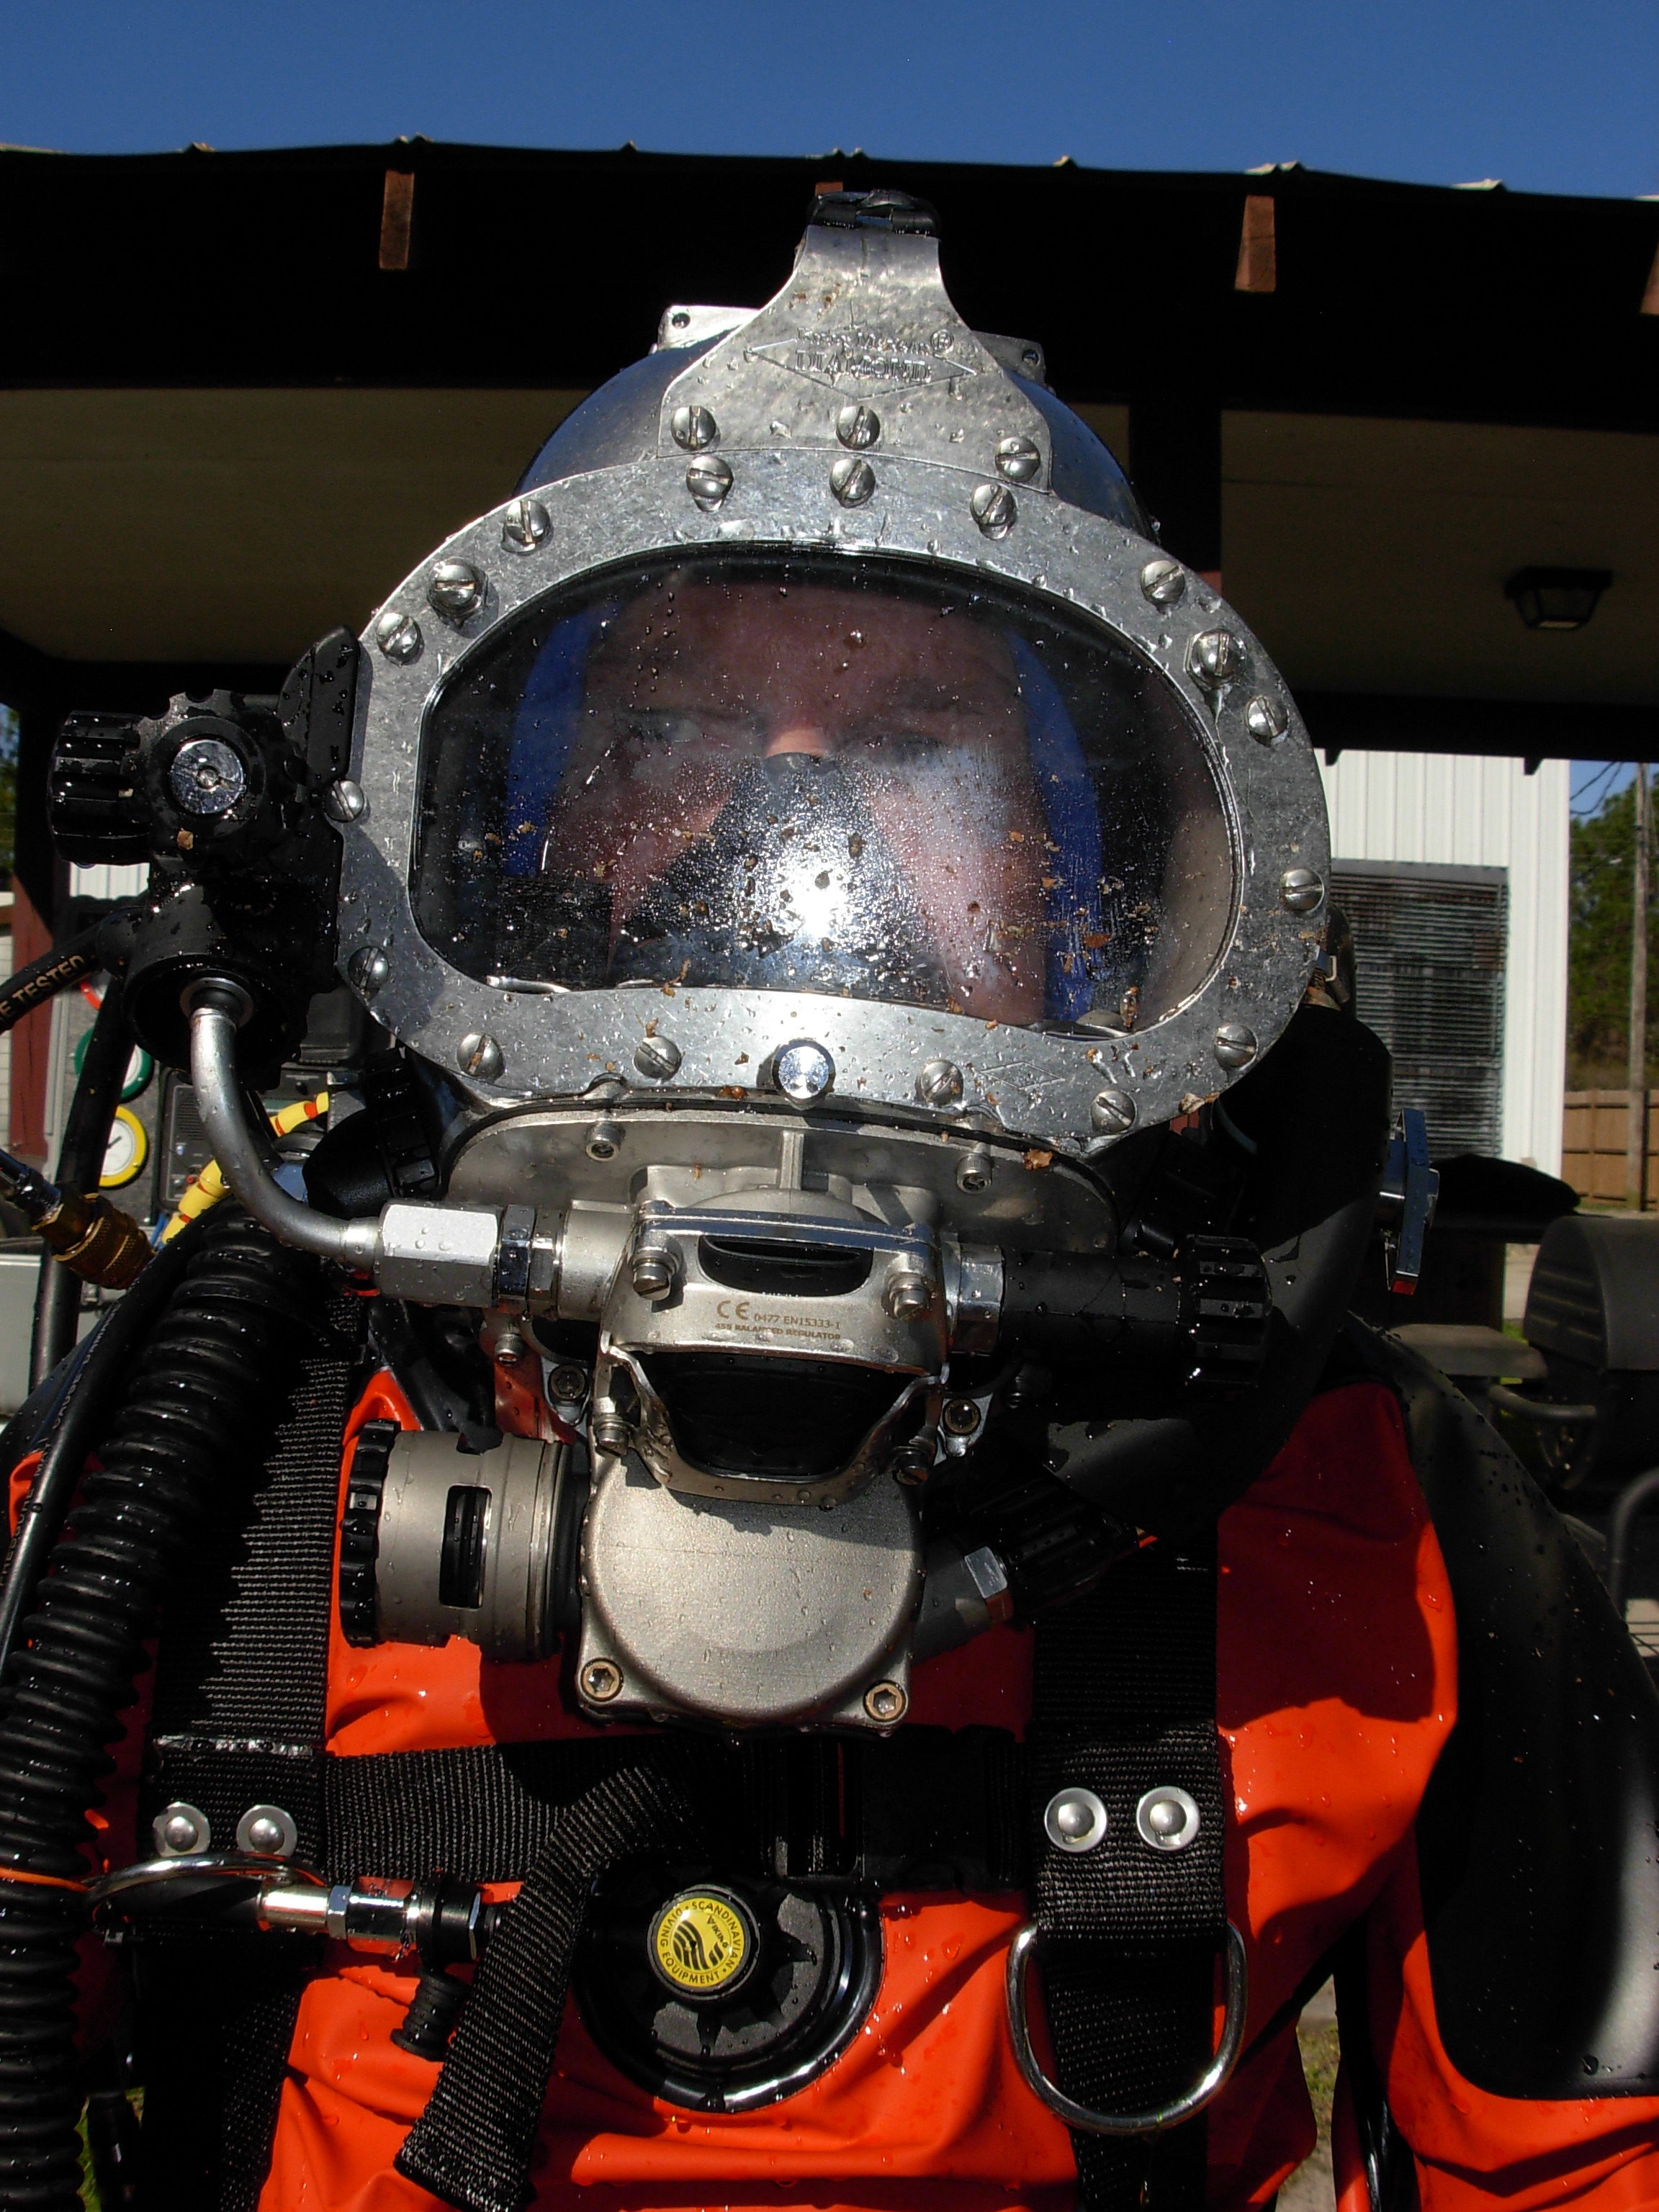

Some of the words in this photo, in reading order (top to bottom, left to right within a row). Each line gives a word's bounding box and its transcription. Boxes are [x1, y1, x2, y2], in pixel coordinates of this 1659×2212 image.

[796, 349, 932, 382] DIAMOND
[786, 1329, 841, 1340] REGULATOR
[660, 1907, 683, 1947] DIVING
[691, 1901, 742, 1969] SCANDINAVIAN
[706, 1915, 729, 1948] VIKING
[662, 1952, 720, 1984] EQUIPMENT
